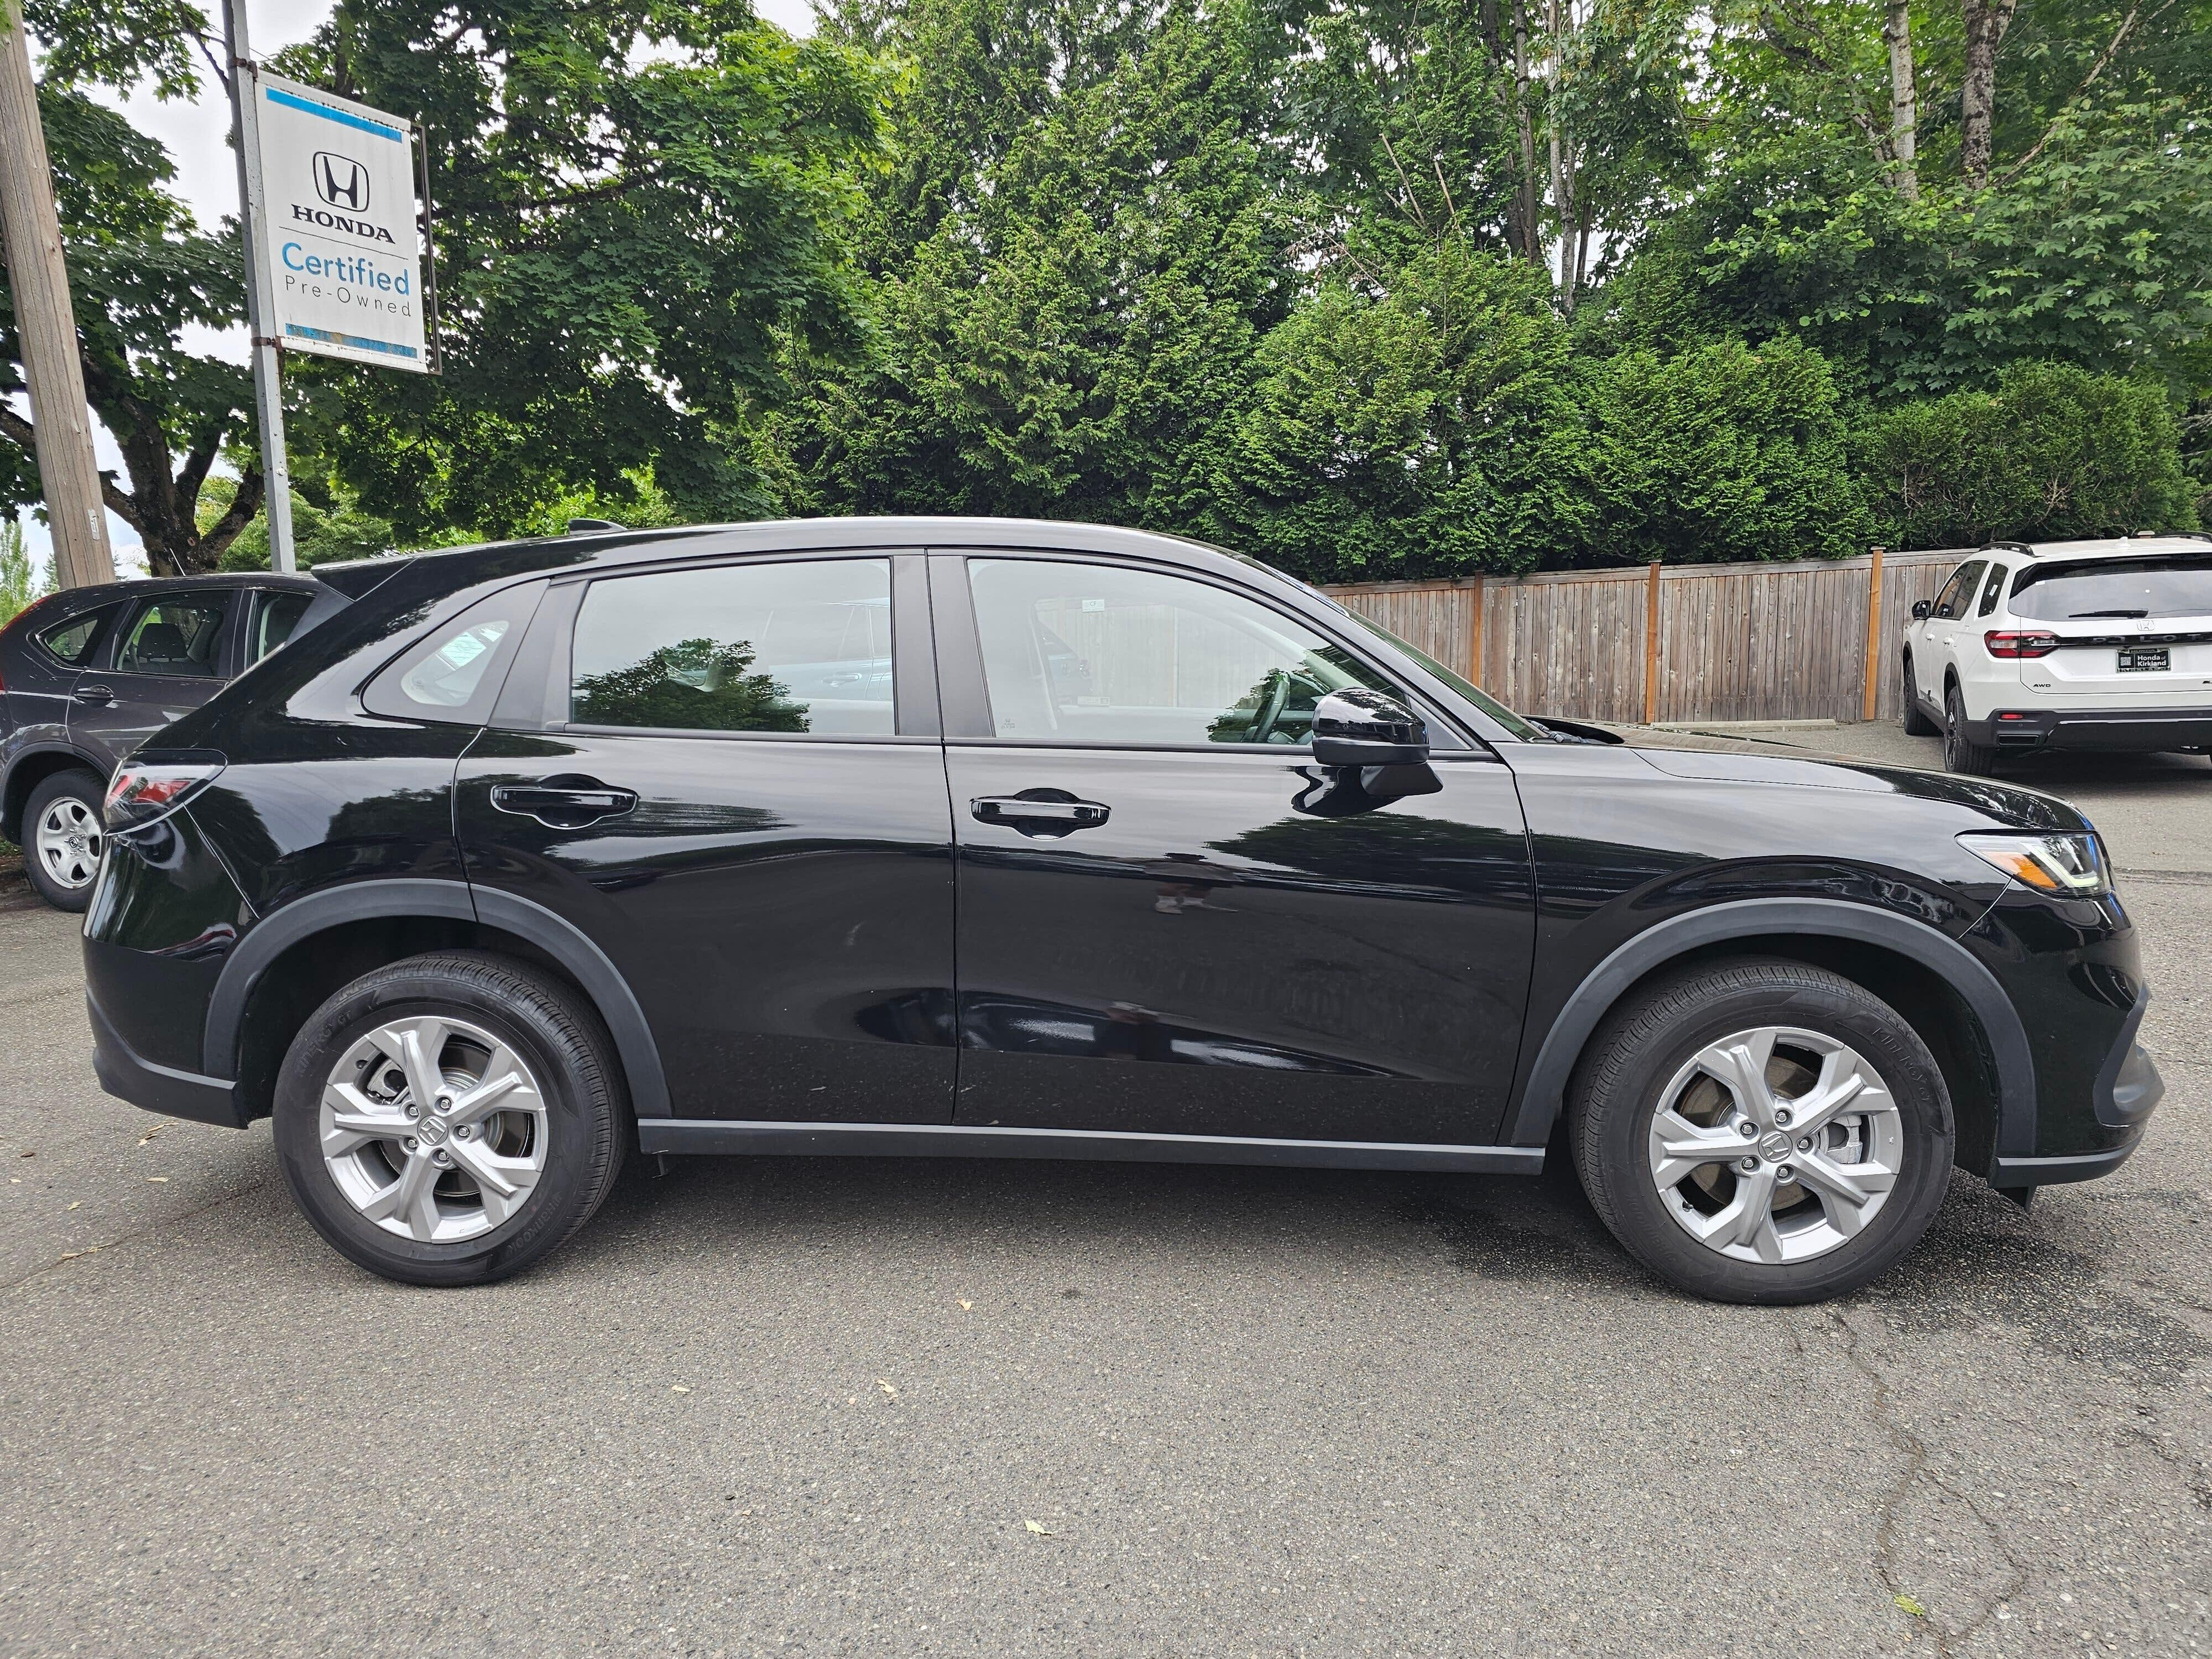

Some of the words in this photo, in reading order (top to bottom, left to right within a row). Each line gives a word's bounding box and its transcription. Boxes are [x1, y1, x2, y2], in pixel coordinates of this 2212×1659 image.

[291, 204, 396, 244] HONDA
[282, 242, 409, 296] Certified
[285, 275, 411, 317] Pre-Owned
